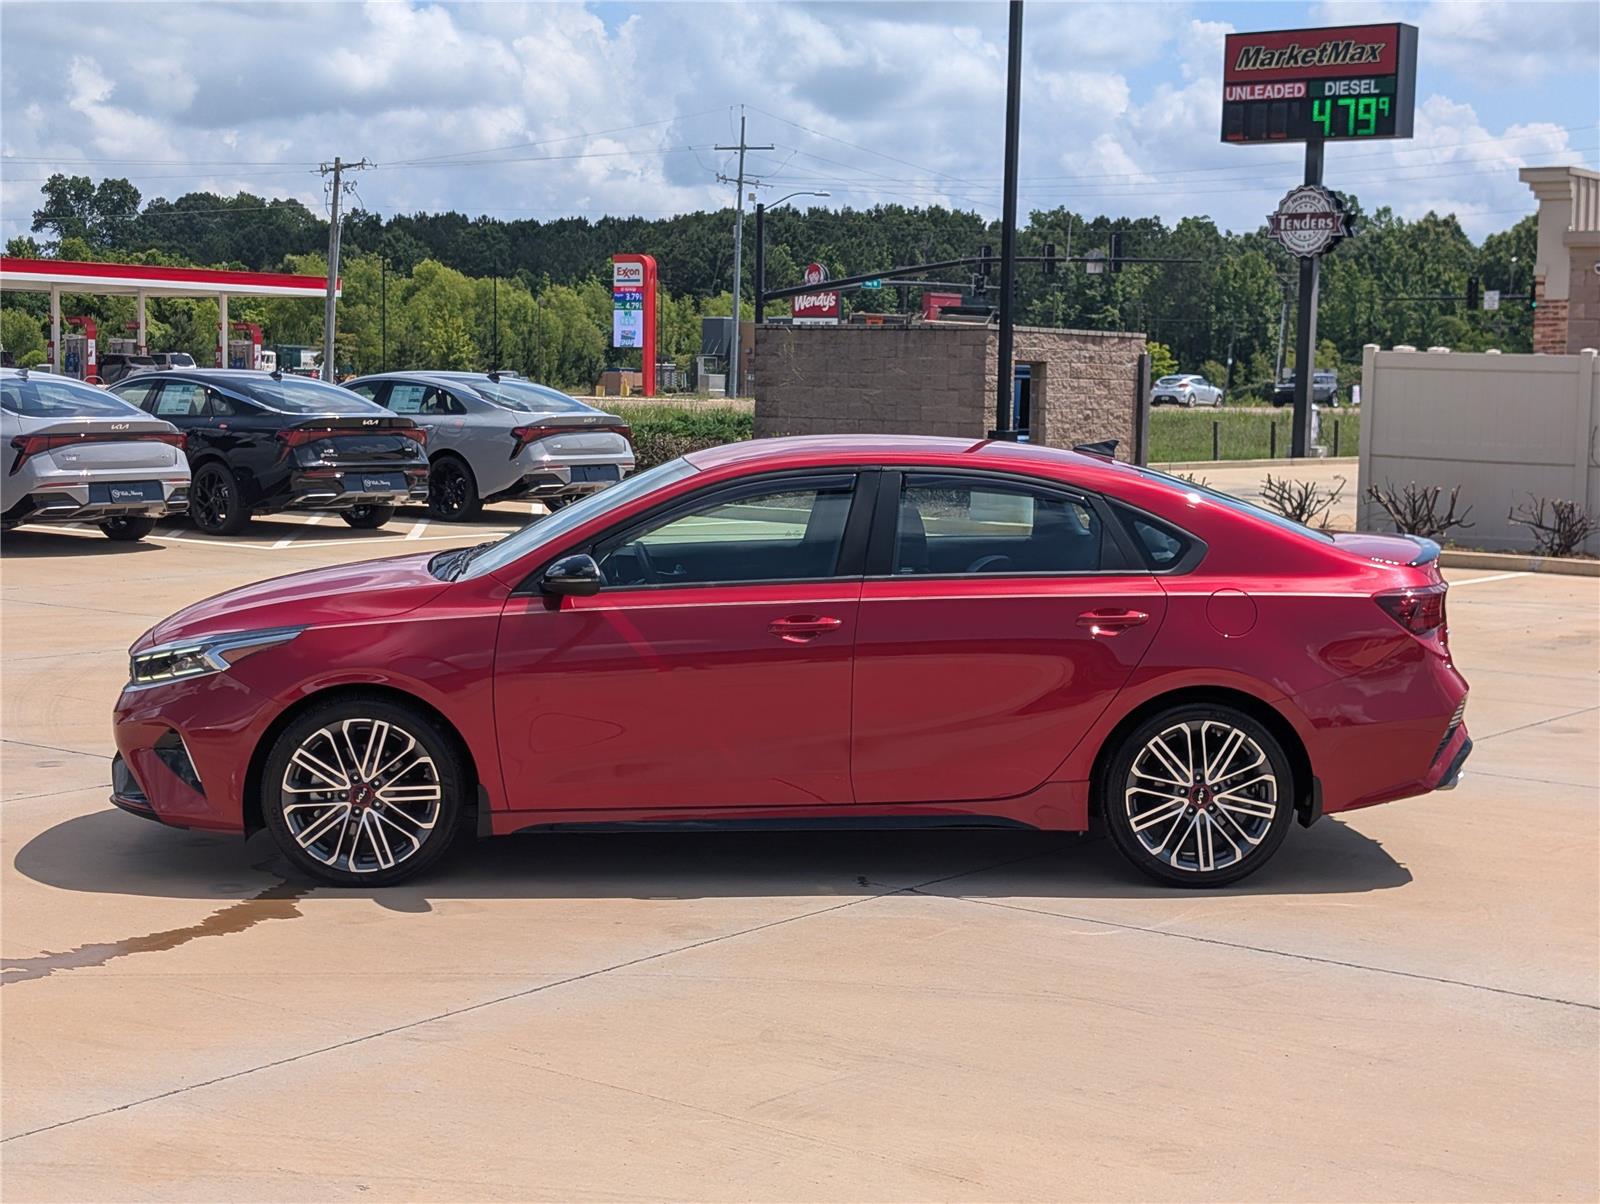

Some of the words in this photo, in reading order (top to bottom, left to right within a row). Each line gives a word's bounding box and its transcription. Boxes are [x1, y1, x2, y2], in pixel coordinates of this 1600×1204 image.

[1234, 40, 1386, 71] MarketMax
[1225, 82, 1305, 101] UNLEADED
[1324, 79, 1380, 96] DIESEL
[616, 267, 640, 278] Exxon
[794, 292, 836, 312] Wendy's
